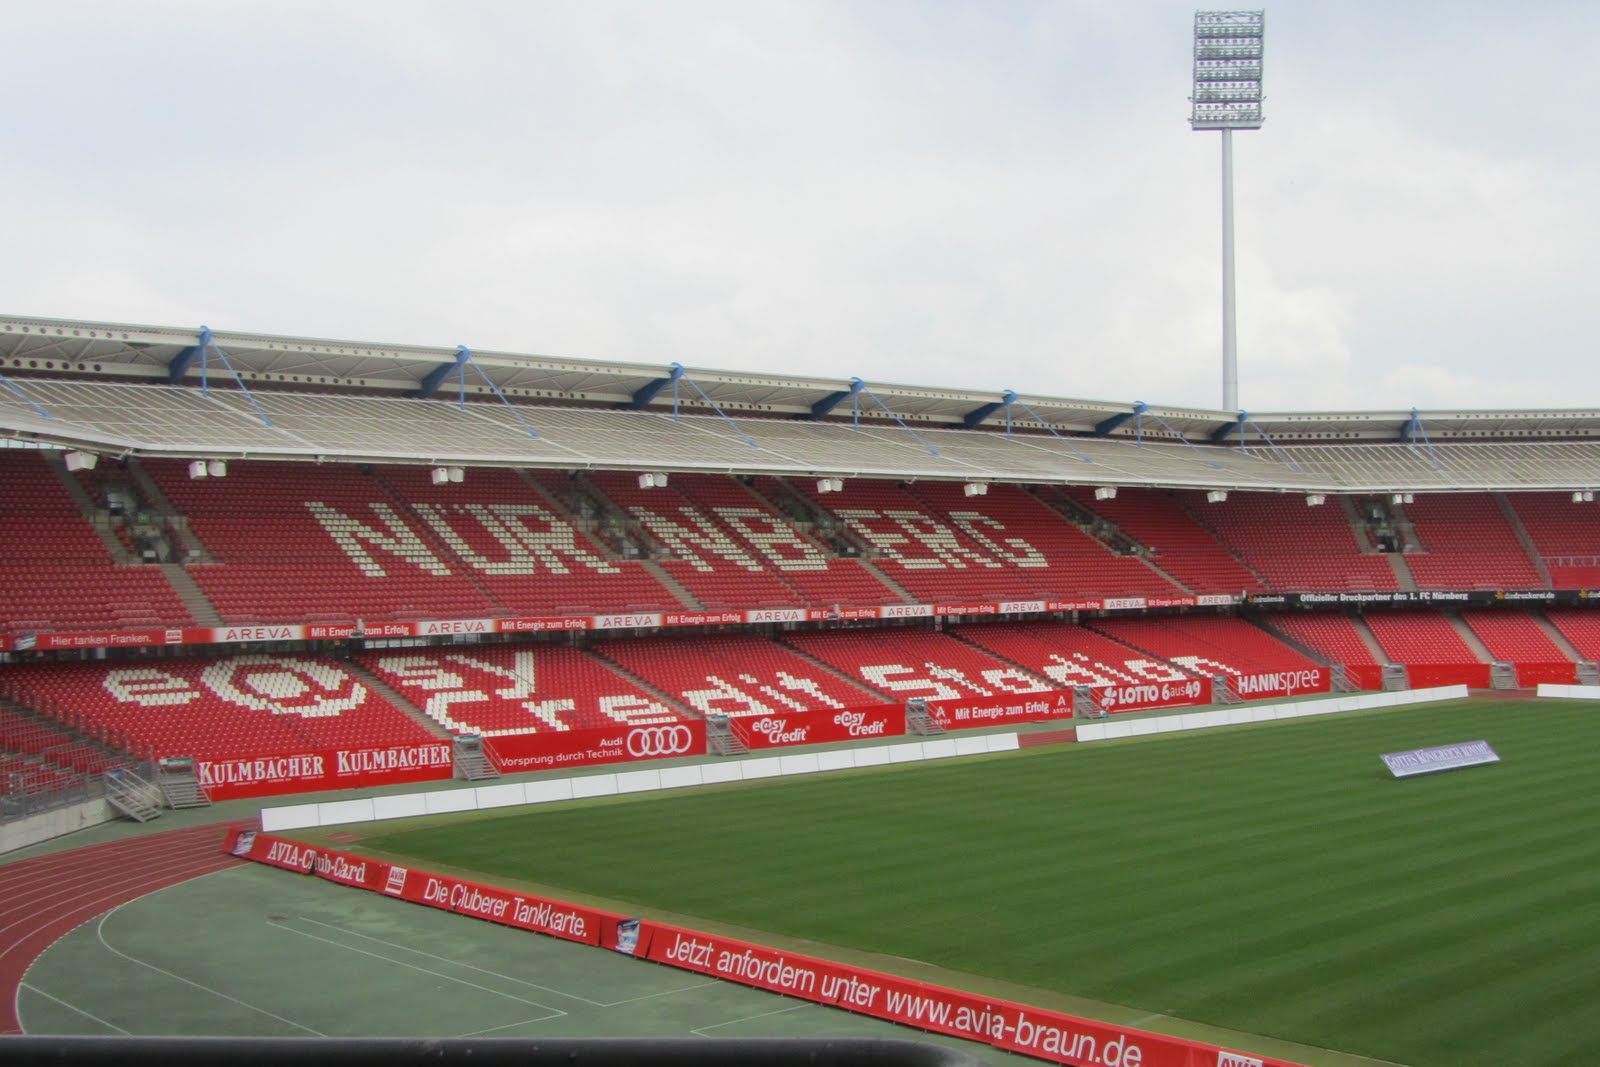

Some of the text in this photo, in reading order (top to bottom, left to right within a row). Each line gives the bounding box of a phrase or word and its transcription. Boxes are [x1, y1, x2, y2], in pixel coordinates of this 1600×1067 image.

[1202, 596, 1230, 604] AREVA
[1340, 593, 1390, 602] Druckpartner
[1420, 592, 1430, 600] FC
[1432, 592, 1468, 601] Nürnberg
[937, 606, 946, 614] Mit
[948, 605, 966, 615] Energie
[980, 604, 995, 614] Erfolg
[1005, 603, 1040, 612] AREVA
[1109, 600, 1140, 609] AREVA
[755, 610, 800, 621] AREVA
[859, 609, 875, 618] Erfolg
[888, 607, 927, 616] AREVA
[501, 620, 515, 630] Mit
[517, 620, 545, 631] Energie
[565, 619, 586, 629] Erfolg
[602, 616, 653, 627] AREVA
[667, 615, 679, 624] Mit
[680, 614, 704, 625] Energie
[722, 613, 741, 623] Erfolg
[311, 627, 326, 637] Mit
[364, 627, 382, 635] zum
[384, 625, 409, 636] Erfolg
[428, 621, 486, 633] AREVA
[51, 634, 152, 646] Hier tanken Franken.
[226, 628, 292, 640] AREVA
[1238, 669, 1320, 695] HANNspree
[1118, 685, 1158, 705] LOTTO
[955, 702, 1049, 720] Mit Energie zum Erfolg
[1053, 707, 1071, 715] AREVA
[834, 711, 865, 726] e@sy
[752, 717, 786, 733] e@sy
[600, 737, 623, 747] Audi
[337, 746, 451, 773] KULMBACHER
[500, 748, 623, 767] Vorsprung durch Technik
[200, 755, 324, 785] KULMBACHER
[424, 878, 587, 937] Die Cluberer Tankkarte.
[666, 933, 1142, 1067] Jetzt anfordern unter www.avia-braun.de
